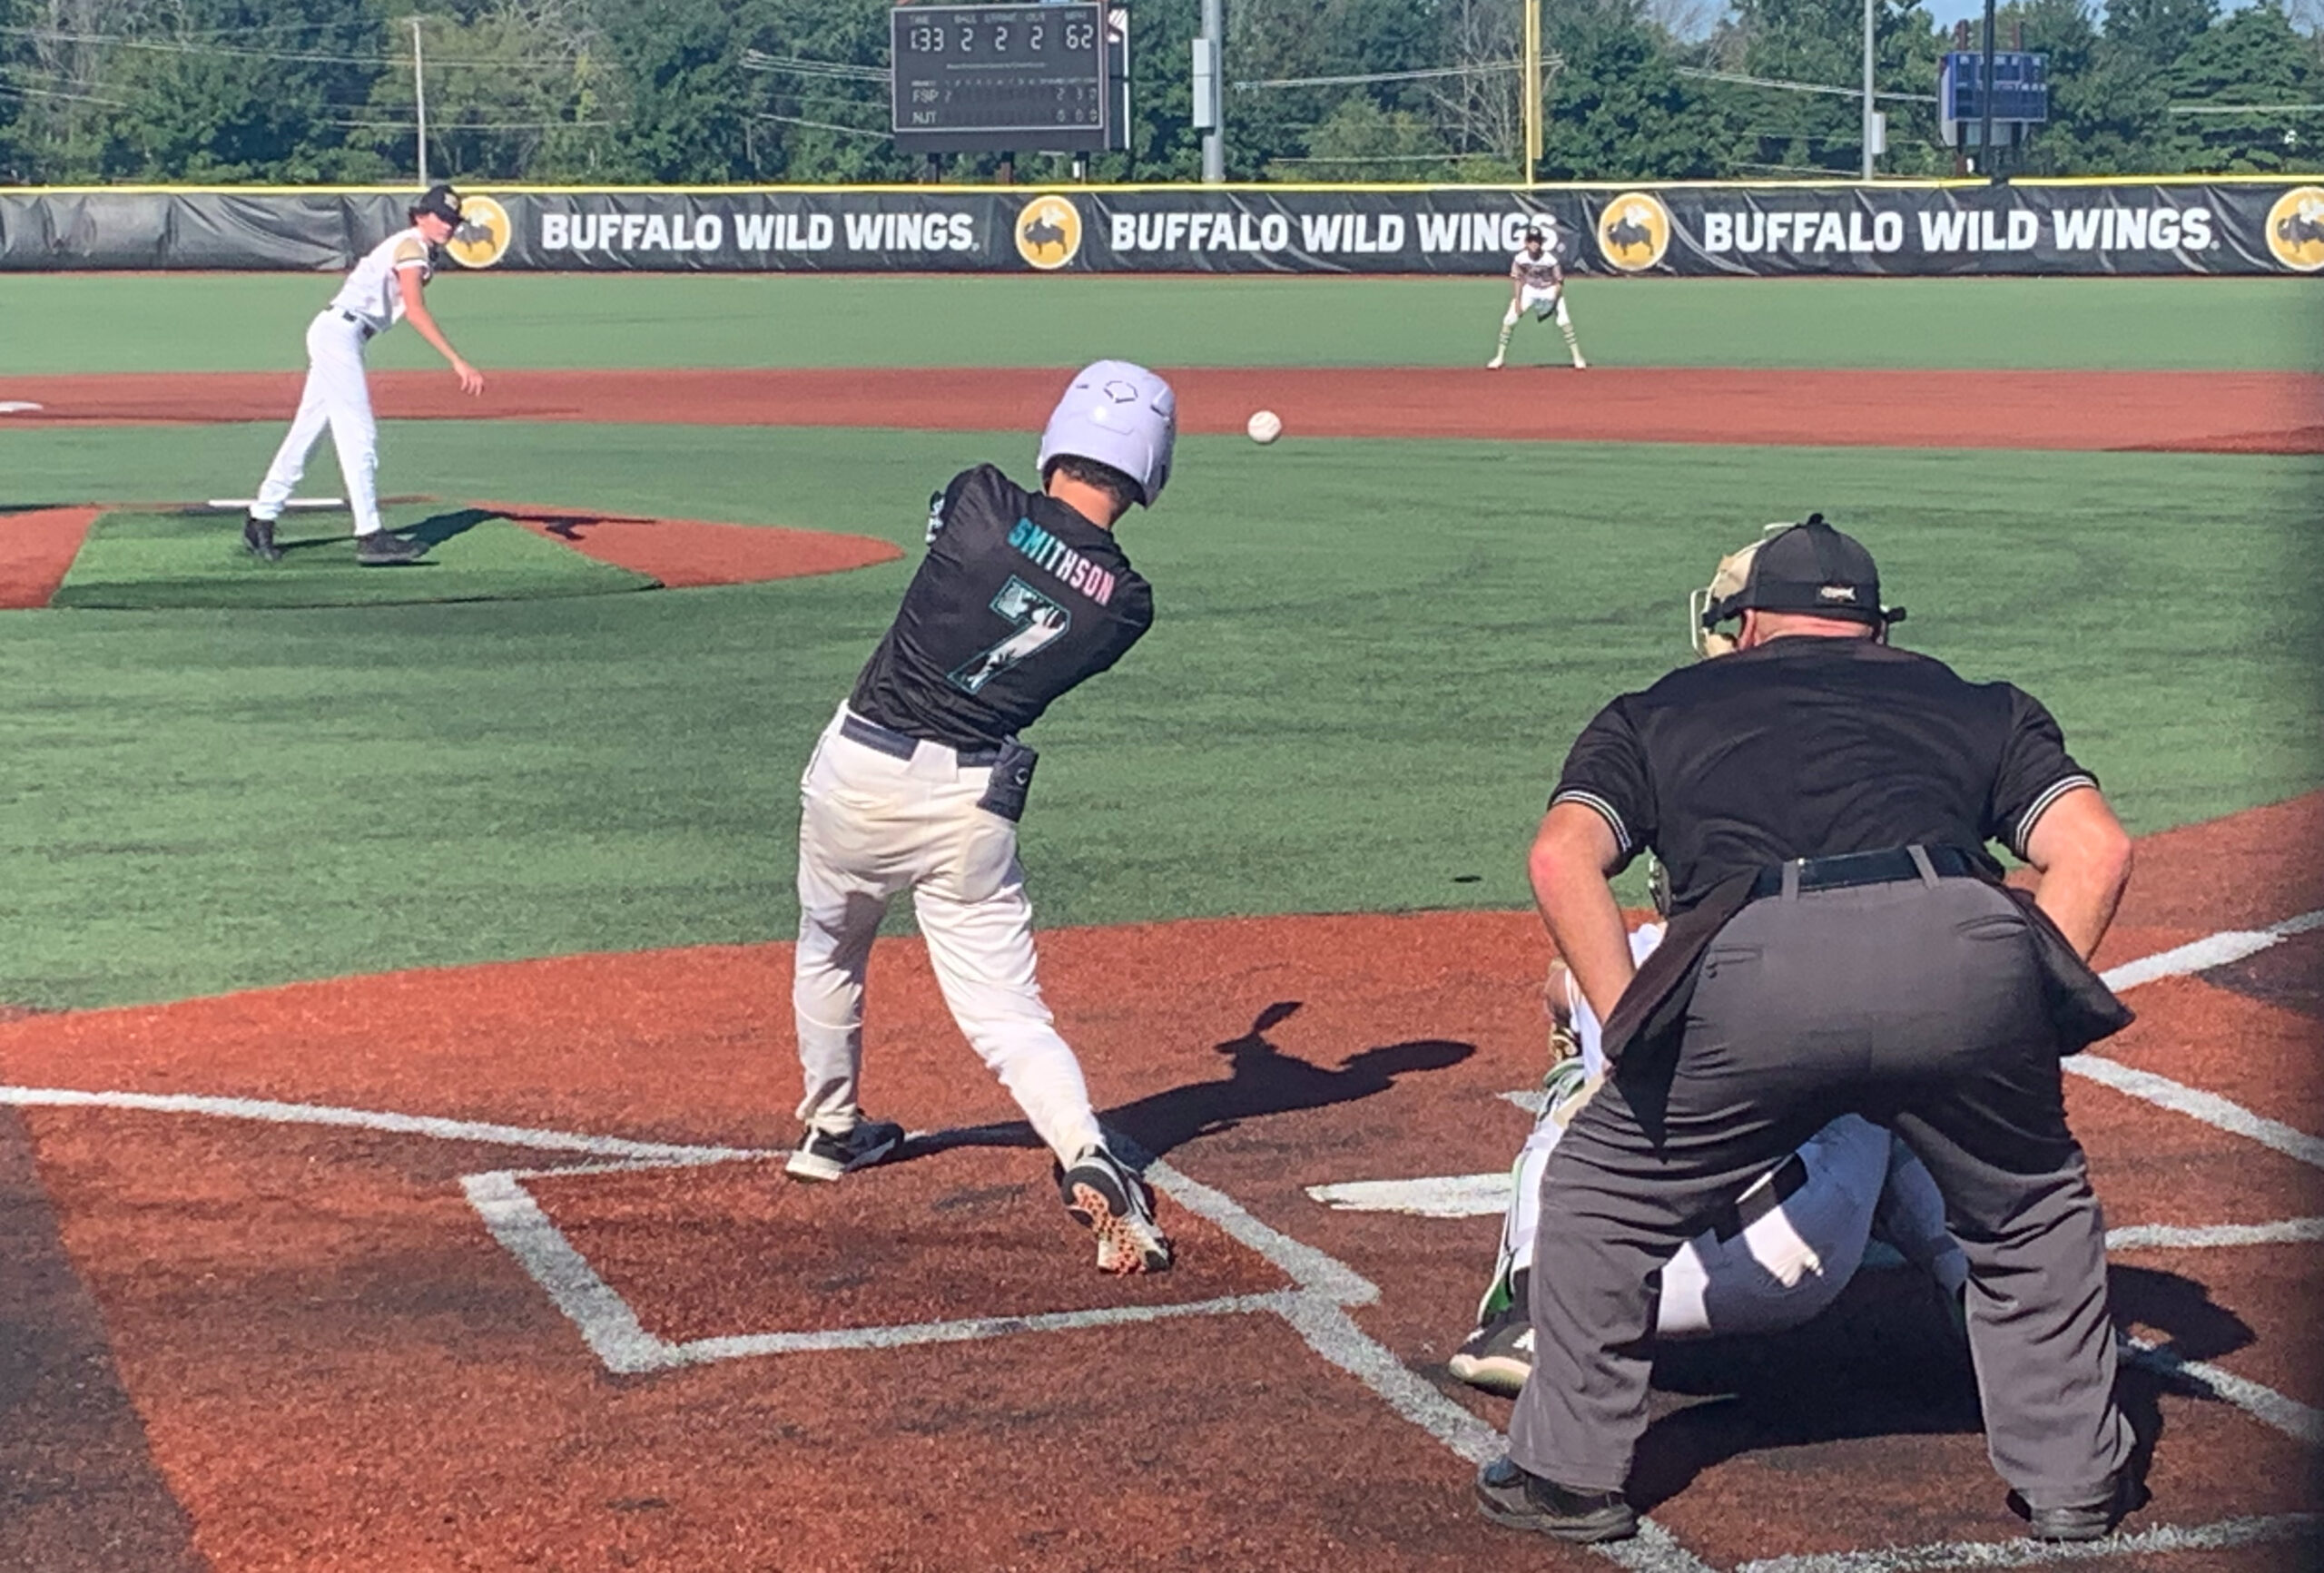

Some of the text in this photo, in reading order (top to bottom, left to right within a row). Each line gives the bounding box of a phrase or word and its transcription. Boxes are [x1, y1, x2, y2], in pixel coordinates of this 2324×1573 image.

[960, 27, 974, 52] 2
[995, 25, 1009, 51] 2
[1030, 25, 1044, 50] 2
[1066, 24, 1094, 49] 62
[542, 214, 722, 250] BUFFALO
[734, 213, 832, 250] WILD
[1111, 213, 1288, 251] BUFFALO
[1301, 214, 1404, 252] WILD
[1704, 211, 1903, 252] BUFFALO
[1919, 211, 2038, 251] WILD
[1008, 516, 1116, 607] SMITHSON
[947, 574, 1071, 695] 7
